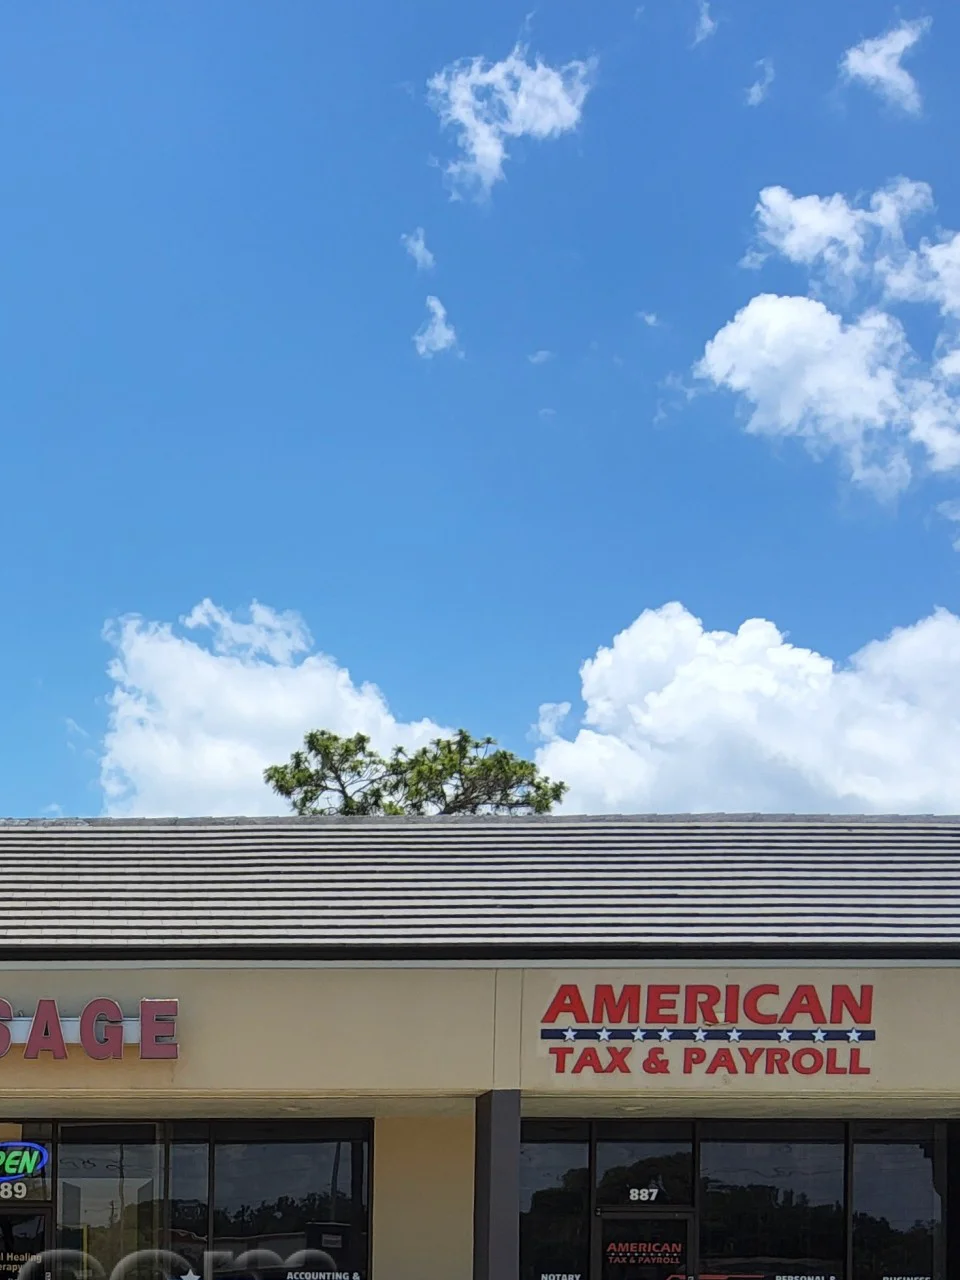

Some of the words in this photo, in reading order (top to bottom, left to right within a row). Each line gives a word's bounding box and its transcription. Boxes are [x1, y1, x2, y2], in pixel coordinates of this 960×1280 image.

[541, 984, 873, 1024] AMERICAN
[549, 1047, 631, 1074] TAX
[642, 1047, 670, 1074] &
[683, 1047, 871, 1074] PAYROLL
[629, 1188, 659, 1201] 887
[606, 1242, 682, 1252] AMERICAN
[6, 1251, 42, 1264] Healing
[608, 1256, 627, 1264] TAX
[629, 1256, 636, 1264] &
[638, 1256, 680, 1264] PAYROLL
[286, 1271, 349, 1280] ACCOUNTING
[352, 1272, 360, 1280] &
